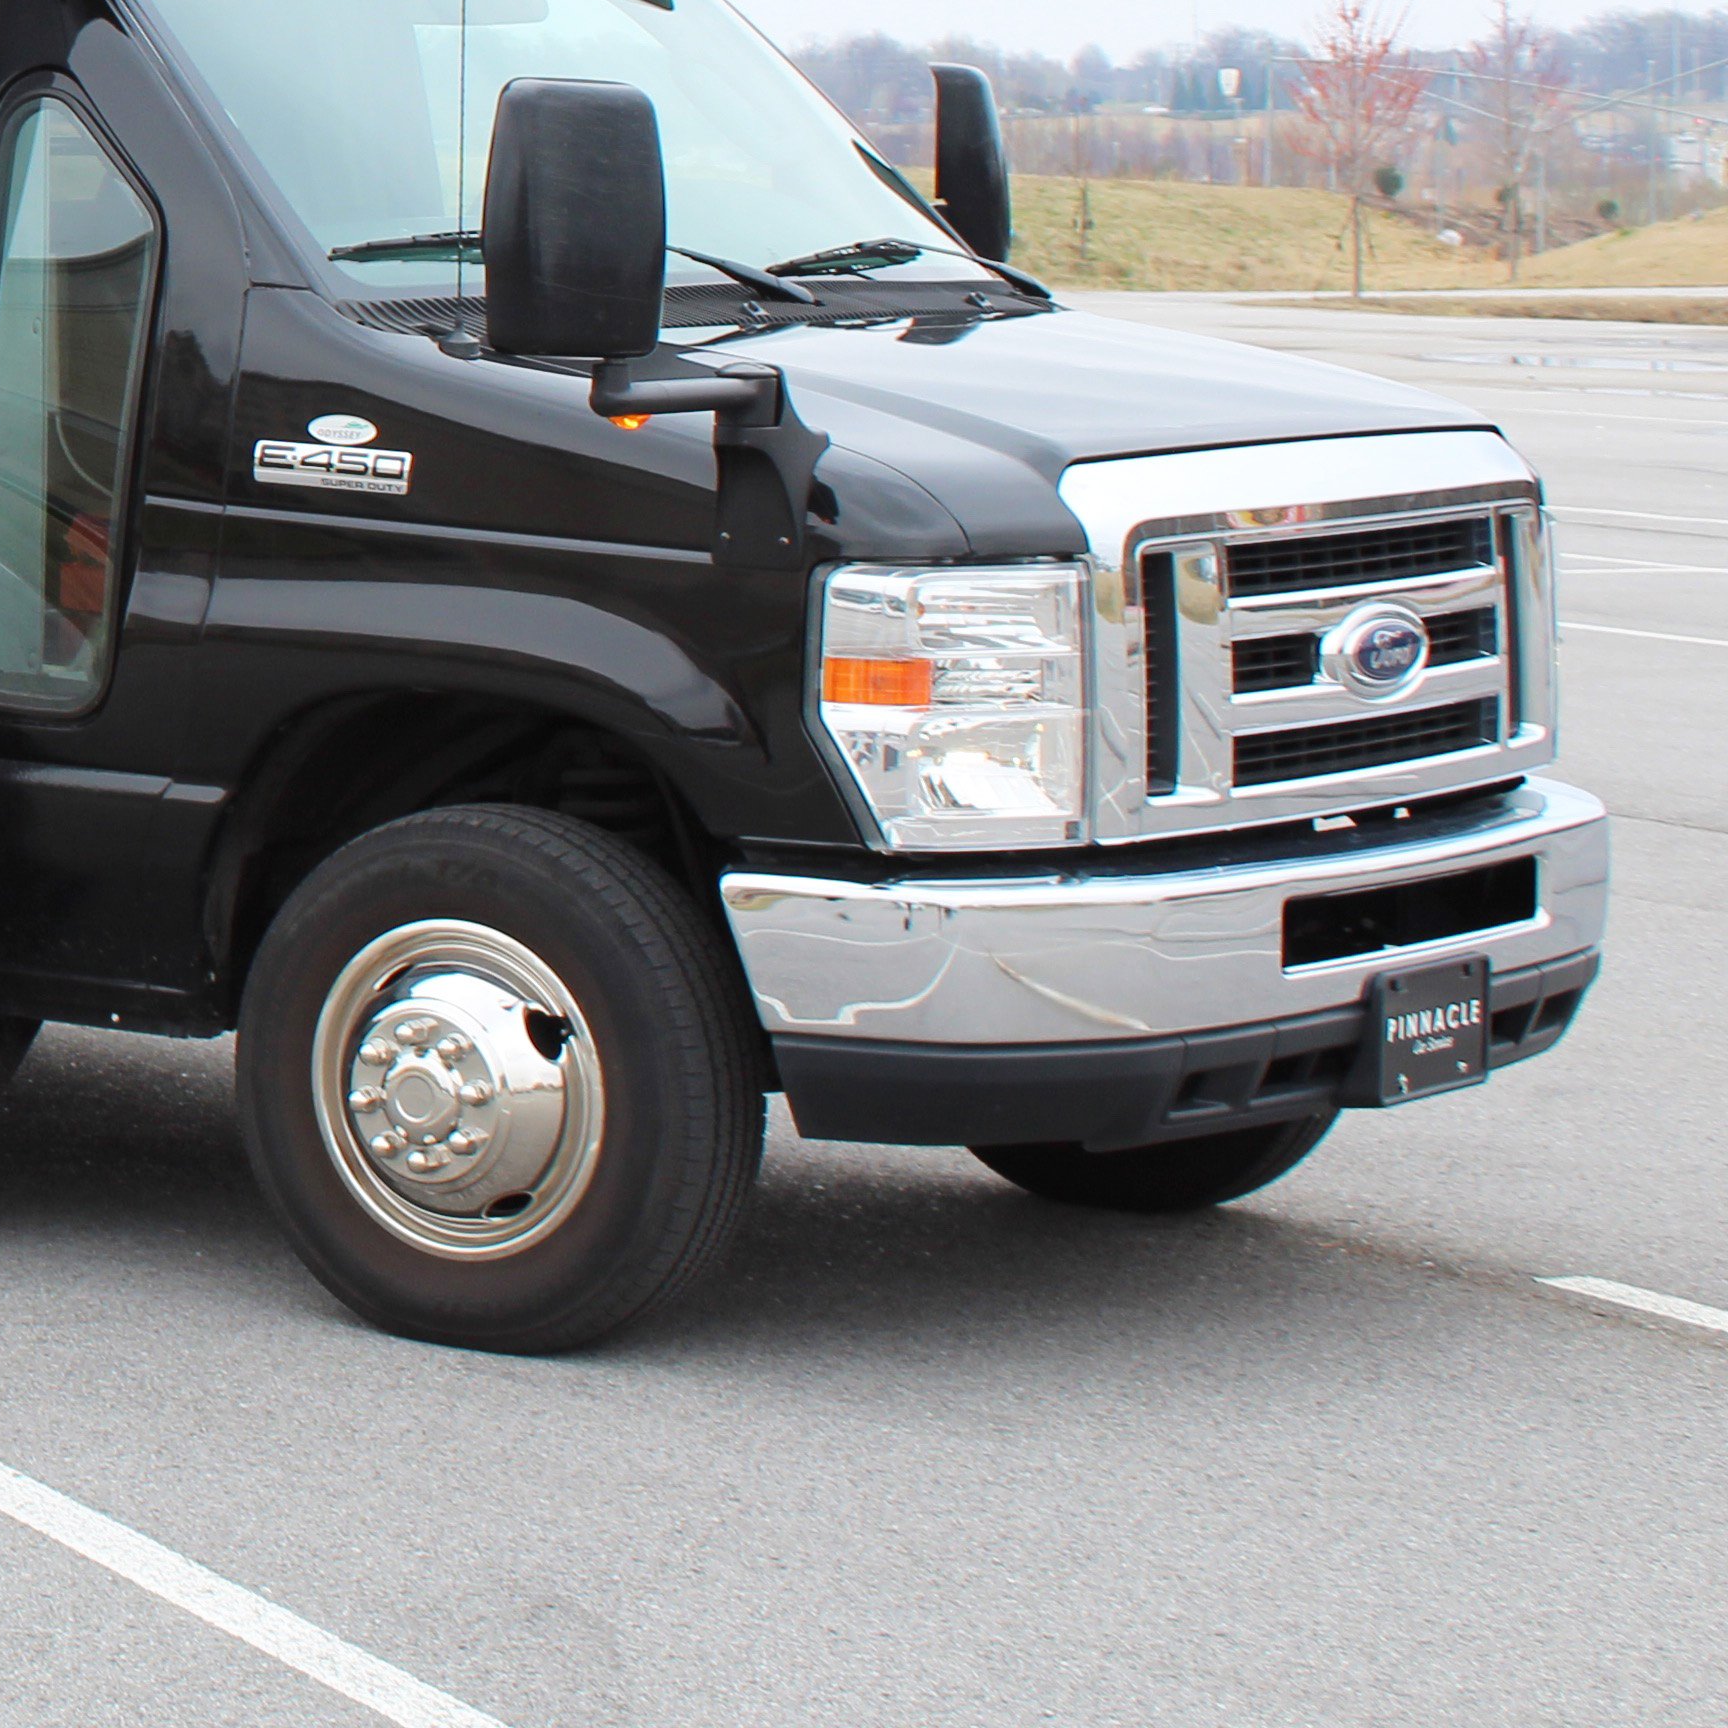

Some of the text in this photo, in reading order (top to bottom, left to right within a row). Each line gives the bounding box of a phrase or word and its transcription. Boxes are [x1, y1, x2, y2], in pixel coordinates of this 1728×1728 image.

[317, 428, 361, 439] ODYSSEY
[321, 477, 404, 493] SUPER DUTY
[1386, 998, 1481, 1043] PINNACLE
